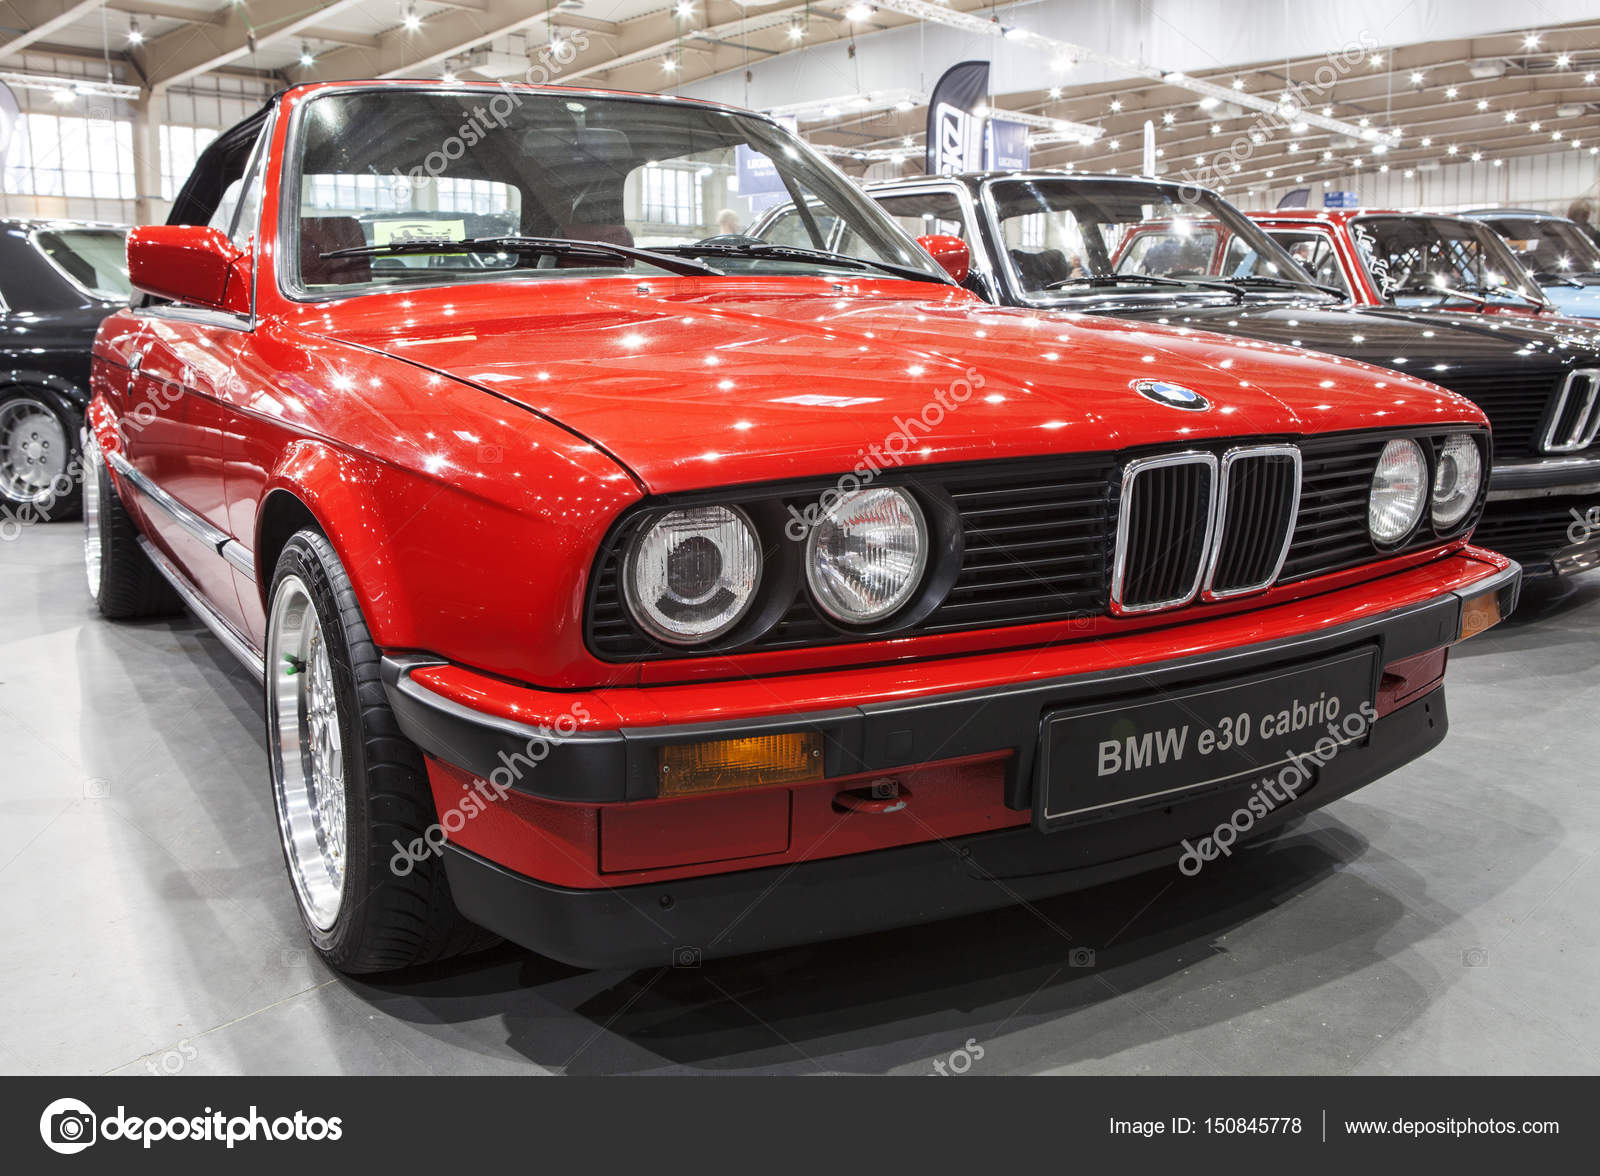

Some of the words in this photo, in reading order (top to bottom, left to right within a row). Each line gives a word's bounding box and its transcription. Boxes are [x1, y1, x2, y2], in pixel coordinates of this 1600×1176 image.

[1097, 725, 1189, 776] BMW
[1197, 712, 1251, 755] e30
[1259, 691, 1340, 740] cabrio
